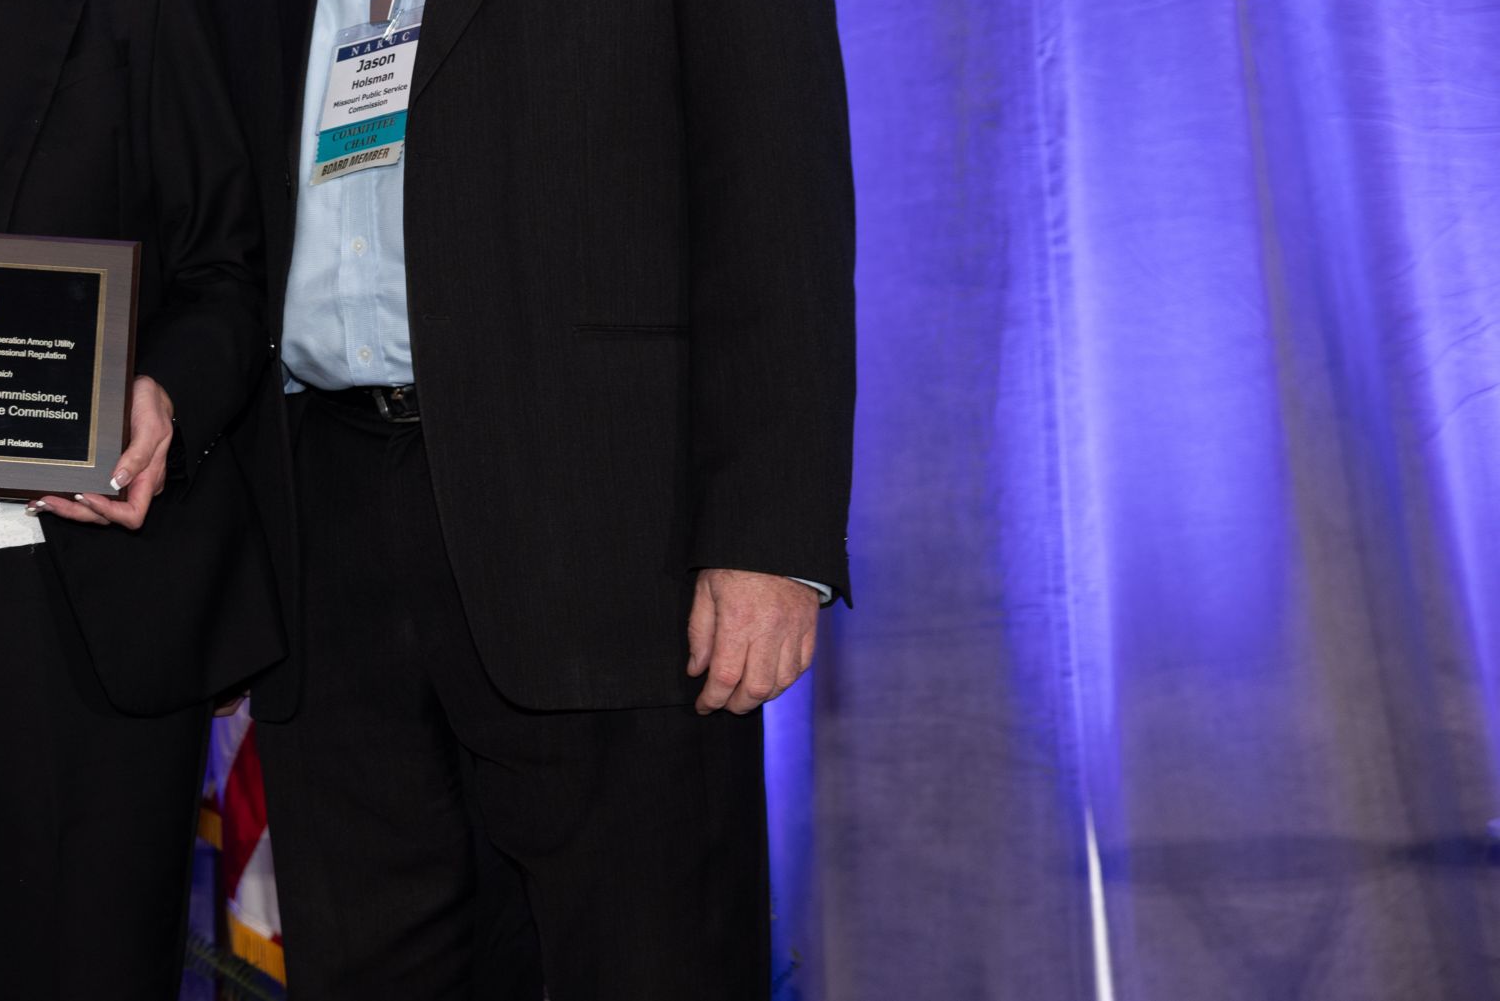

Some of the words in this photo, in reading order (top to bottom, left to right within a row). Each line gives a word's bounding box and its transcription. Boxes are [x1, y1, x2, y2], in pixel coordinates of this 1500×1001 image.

[356, 53, 396, 73] Jason
[351, 71, 394, 90] Holsman
[333, 94, 360, 108] Missouri
[361, 89, 382, 101] Public
[383, 84, 408, 95] Service
[348, 98, 388, 114] Commission
[332, 117, 396, 142] COMMITTEE
[344, 134, 378, 151] CHAIR
[321, 157, 349, 177] BOARD
[349, 147, 391, 167] MEMBER
[27, 338, 53, 348] Among
[54, 339, 75, 350] Utility
[27, 350, 67, 360] Regulation
[8, 405, 78, 420] Commission
[7, 438, 43, 449] Relations
